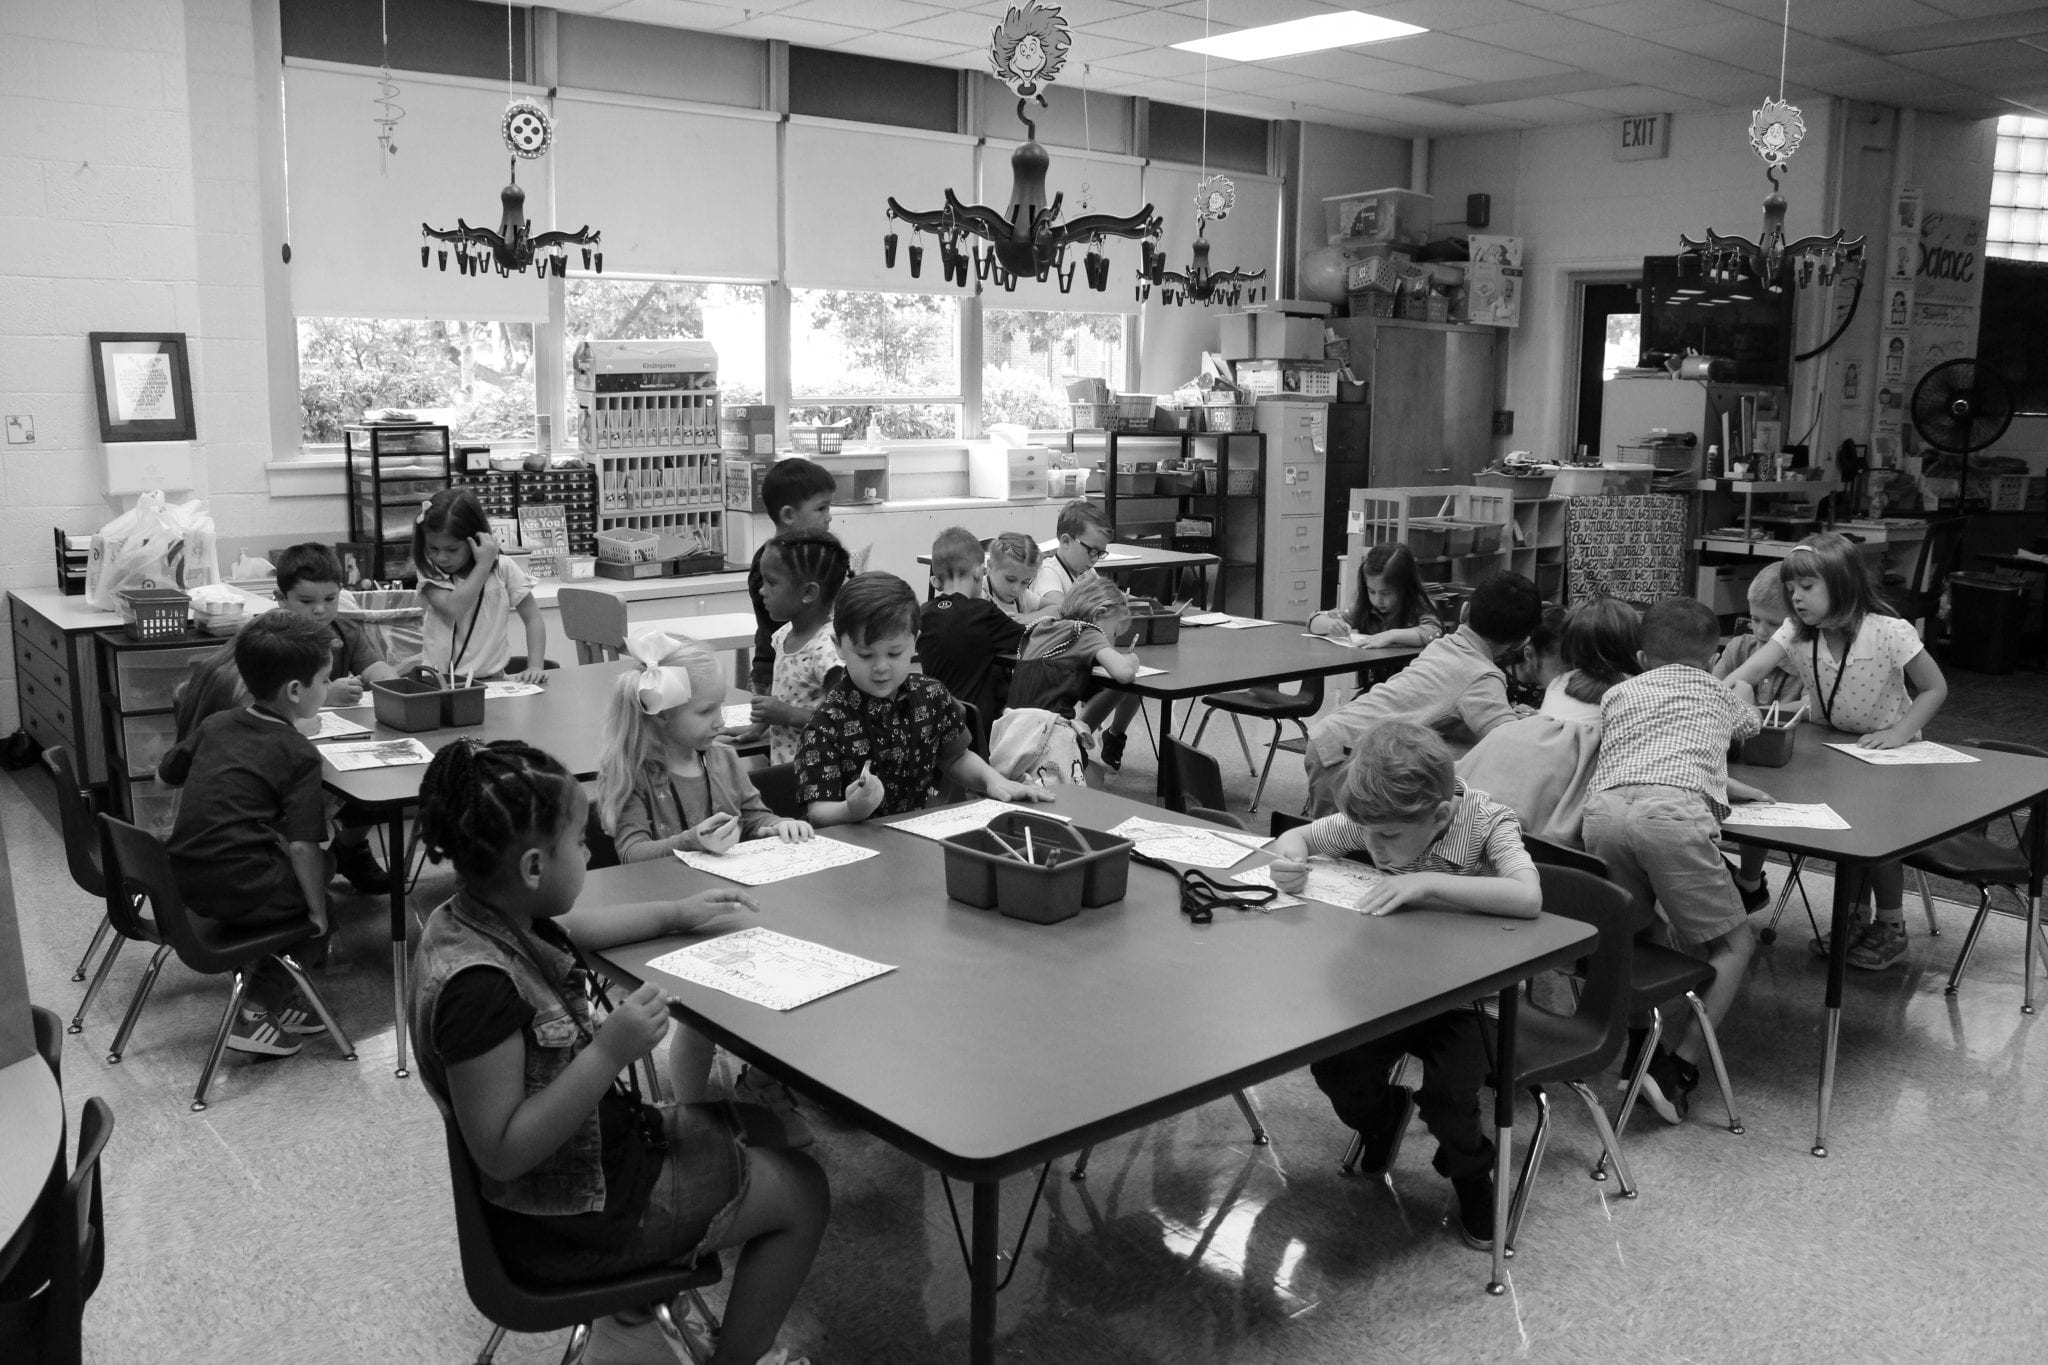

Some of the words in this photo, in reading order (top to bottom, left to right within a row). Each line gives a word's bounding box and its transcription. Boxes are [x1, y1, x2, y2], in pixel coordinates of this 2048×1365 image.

[1622, 117, 1657, 147] EXIT
[522, 508, 562, 517] TODAY
[539, 517, 565, 528] You!
